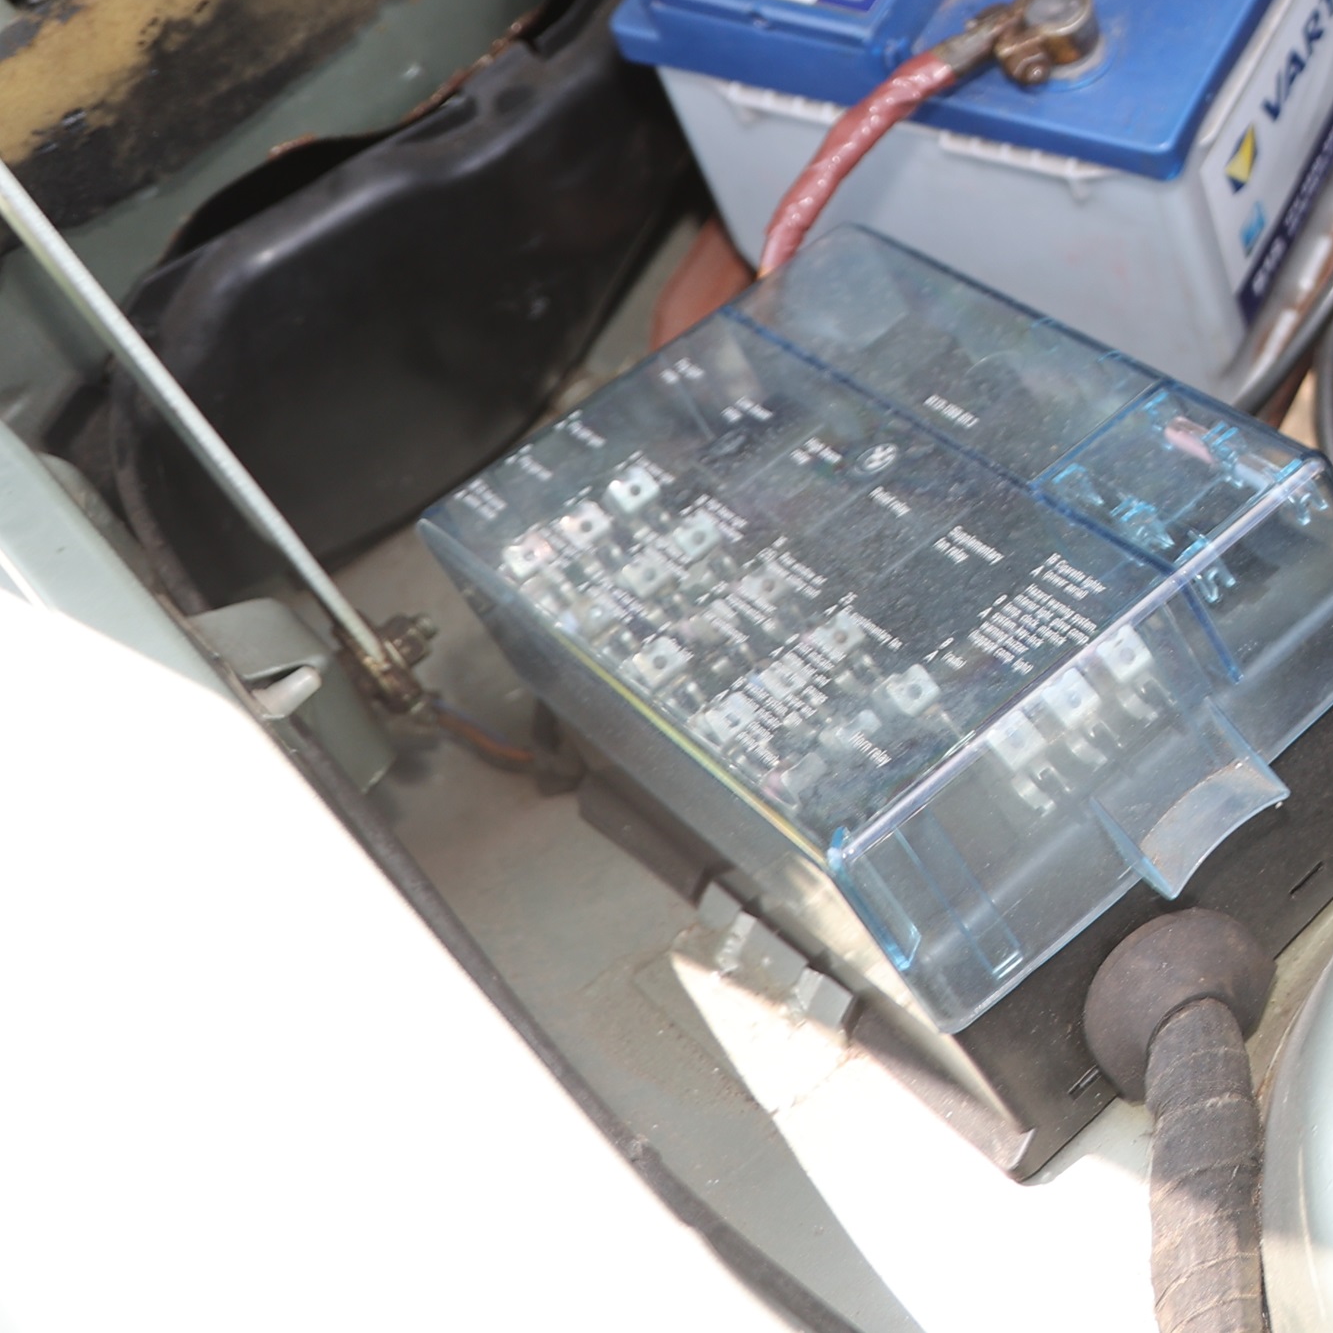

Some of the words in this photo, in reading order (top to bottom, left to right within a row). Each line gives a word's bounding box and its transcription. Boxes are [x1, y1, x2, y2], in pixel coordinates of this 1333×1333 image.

[885, 498, 912, 518] relay
[932, 536, 953, 552] fan
[942, 544, 970, 565] relay
[946, 525, 1006, 565] Supplementary
[1029, 564, 1045, 576] A
[1040, 569, 1069, 589] (power
[1063, 582, 1088, 600] aerial)
[1044, 552, 1060, 565] 16
[1052, 559, 1087, 584] Cigarette
[1080, 575, 1107, 595] lighter
[696, 591, 710, 603] A
[838, 591, 857, 606] 25
[1023, 583, 1052, 604] Hazard
[1044, 598, 1075, 619] warning
[823, 603, 838, 615] A
[1012, 593, 1040, 613] interior
[1050, 616, 1072, 633] glove
[845, 611, 894, 644] supplementary
[977, 606, 993, 619] A
[1012, 626, 1045, 648] key-lock
[993, 594, 1007, 606] 8
[1034, 624, 1067, 646] interlock
[938, 636, 954, 649] 8
[977, 621, 1008, 642] warning
[1002, 636, 1029, 655] buzzer
[769, 645, 784, 657] A
[923, 649, 940, 662] A
[939, 650, 967, 670] (radio)
[964, 629, 999, 654] (luggage
[1008, 657, 1034, 676] light)
[715, 688, 730, 699] A
[742, 681, 770, 701] washer
[800, 684, 829, 705] gauges
[798, 704, 816, 718] and
[847, 731, 876, 752] Horn
[864, 745, 894, 768] relay
